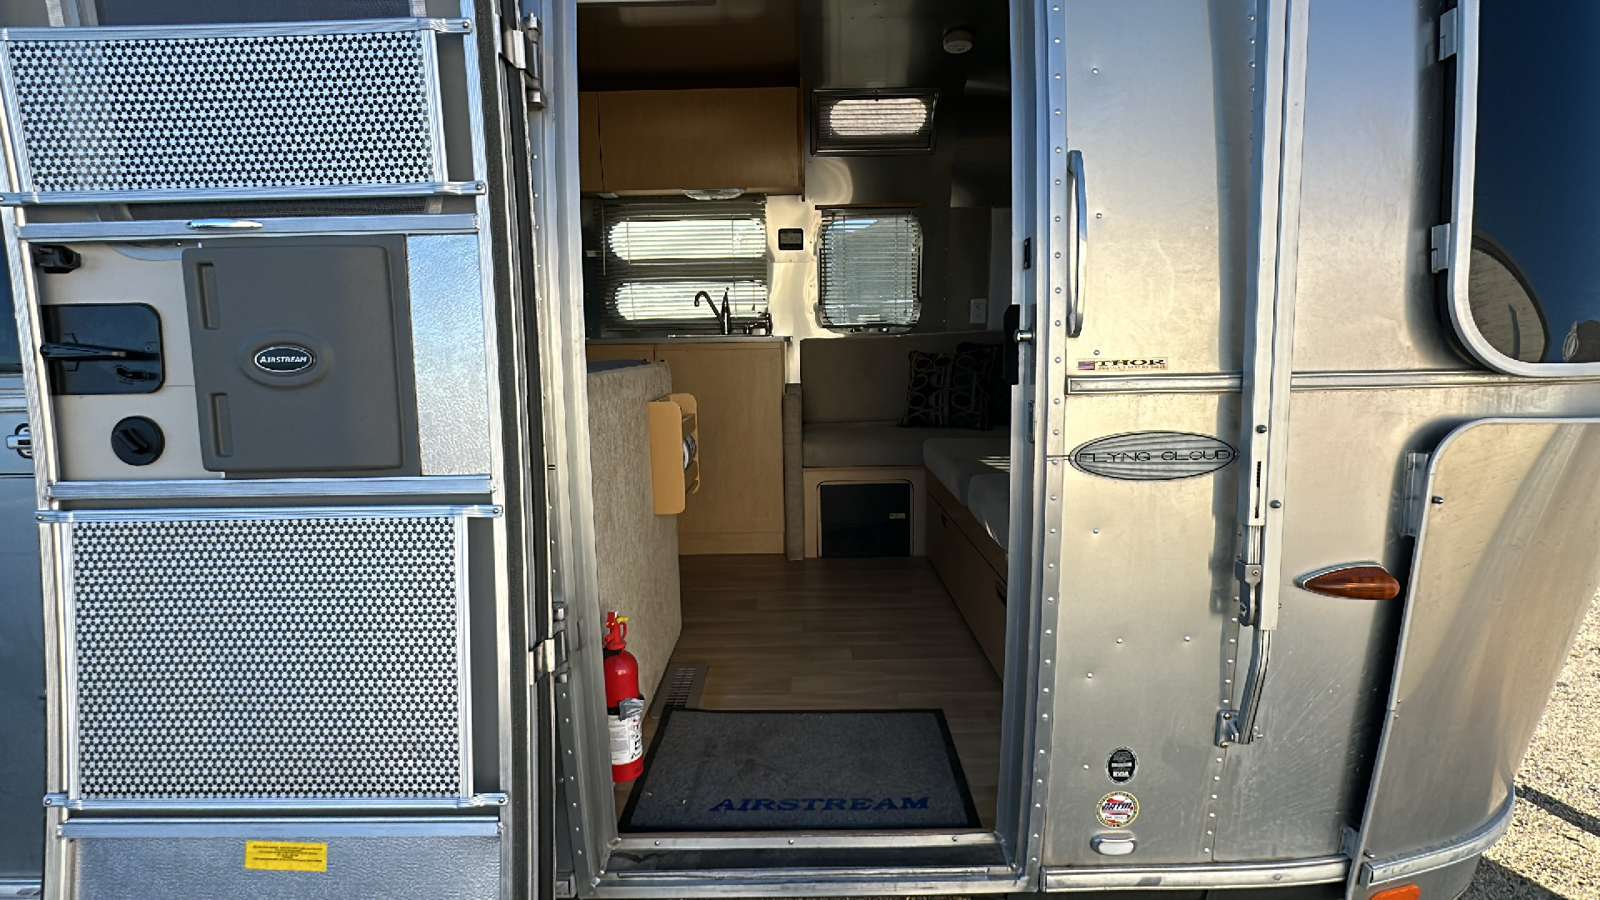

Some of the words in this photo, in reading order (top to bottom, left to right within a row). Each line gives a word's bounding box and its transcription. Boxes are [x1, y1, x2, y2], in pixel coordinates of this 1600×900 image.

[259, 355, 308, 364] AIRSTREAM
[1095, 359, 1166, 367] THOR
[1160, 449, 1231, 461] CLOUD
[708, 796, 931, 812] AIRSTREAM
